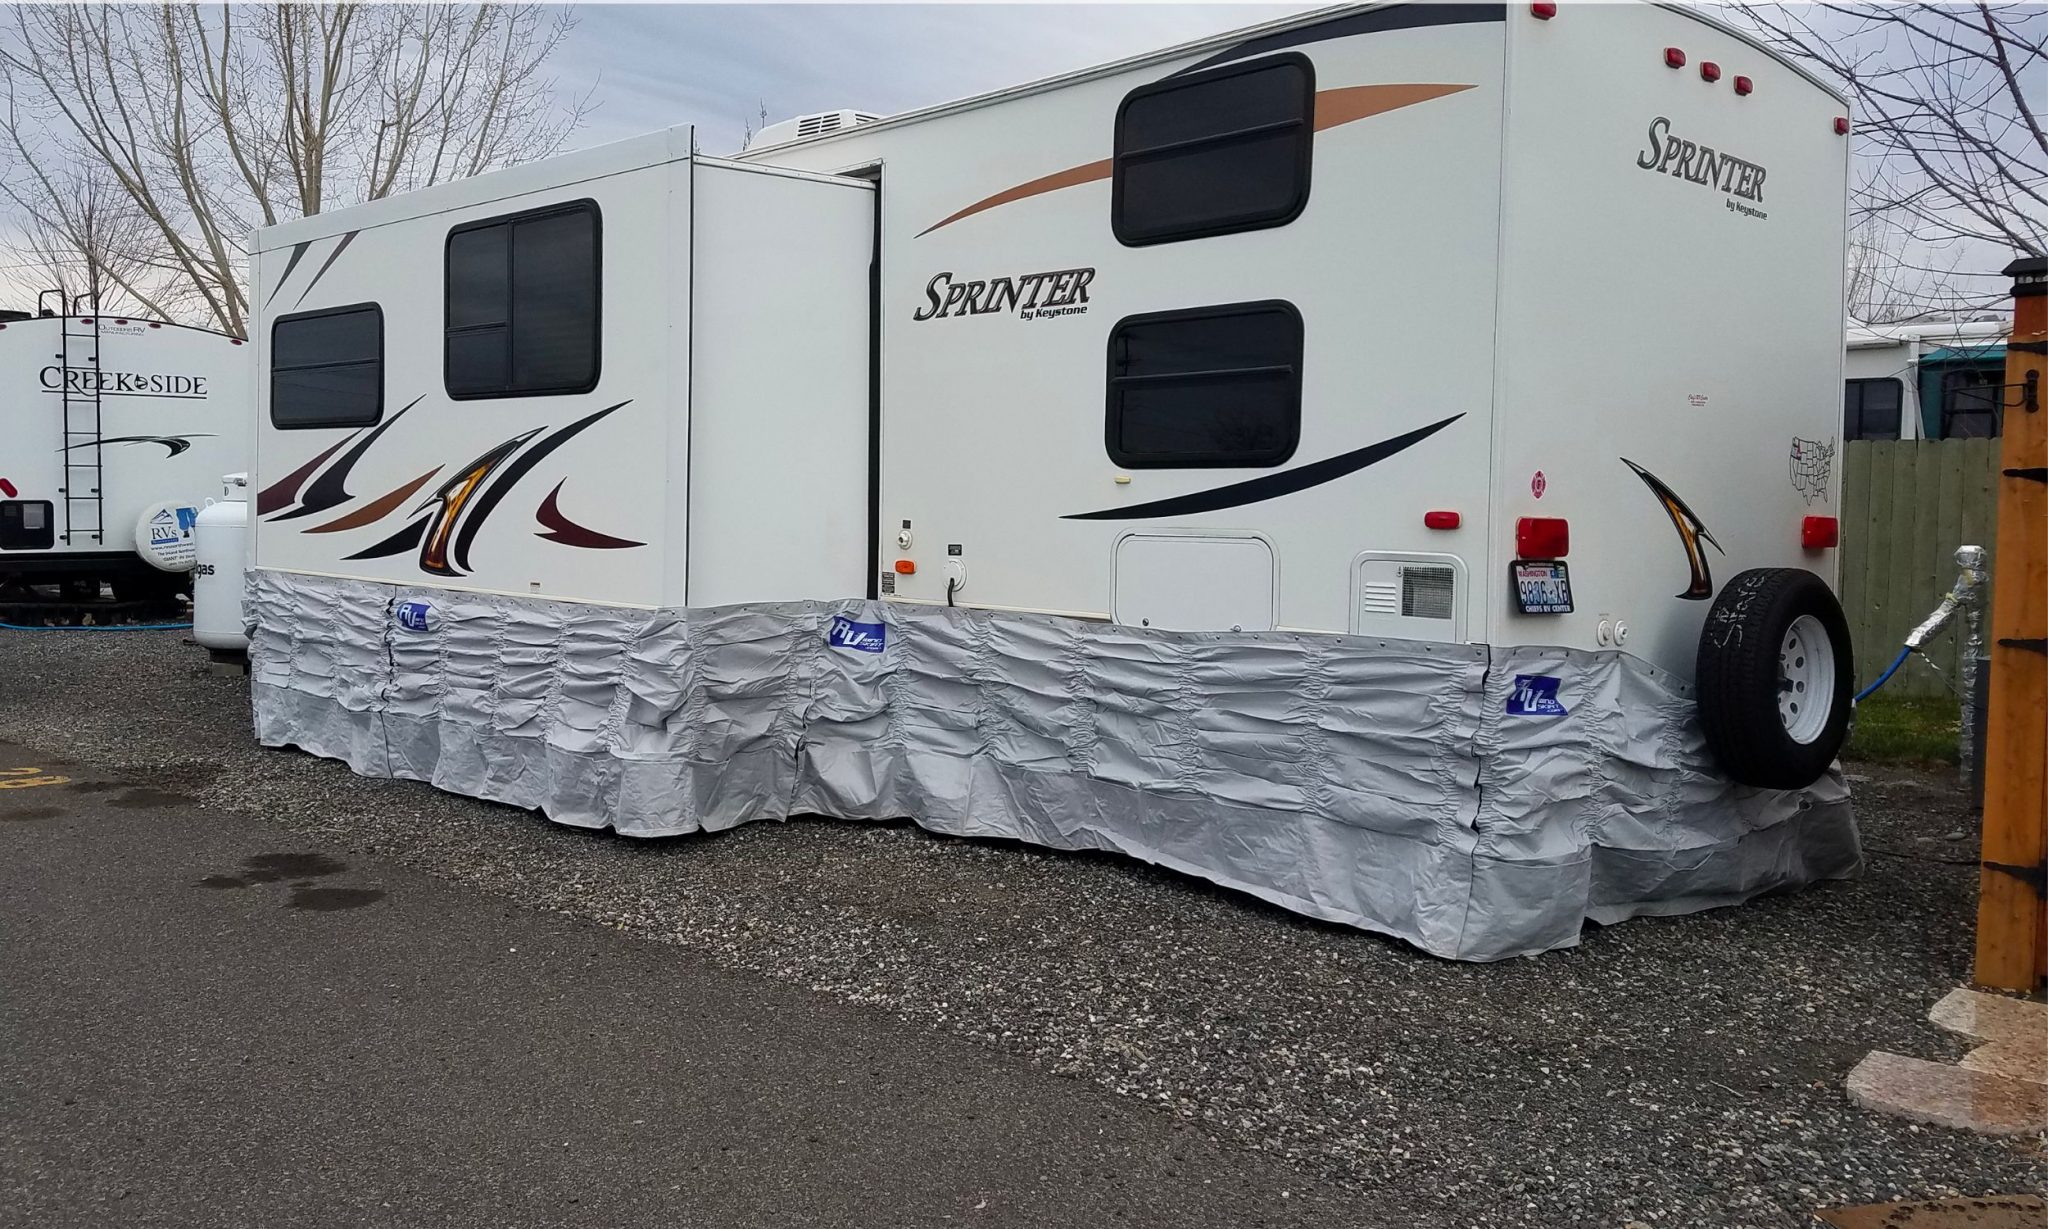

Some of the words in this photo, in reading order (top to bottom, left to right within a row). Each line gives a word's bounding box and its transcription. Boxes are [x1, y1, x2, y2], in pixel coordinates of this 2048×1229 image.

[1637, 116, 1767, 203] SPRINTER
[1726, 198, 1735, 212] by
[1736, 202, 1768, 220] Keystone
[912, 267, 1096, 322] SPRINTER
[1020, 310, 1033, 321] by
[1035, 306, 1088, 319] Keystone
[151, 526, 177, 539] RVs
